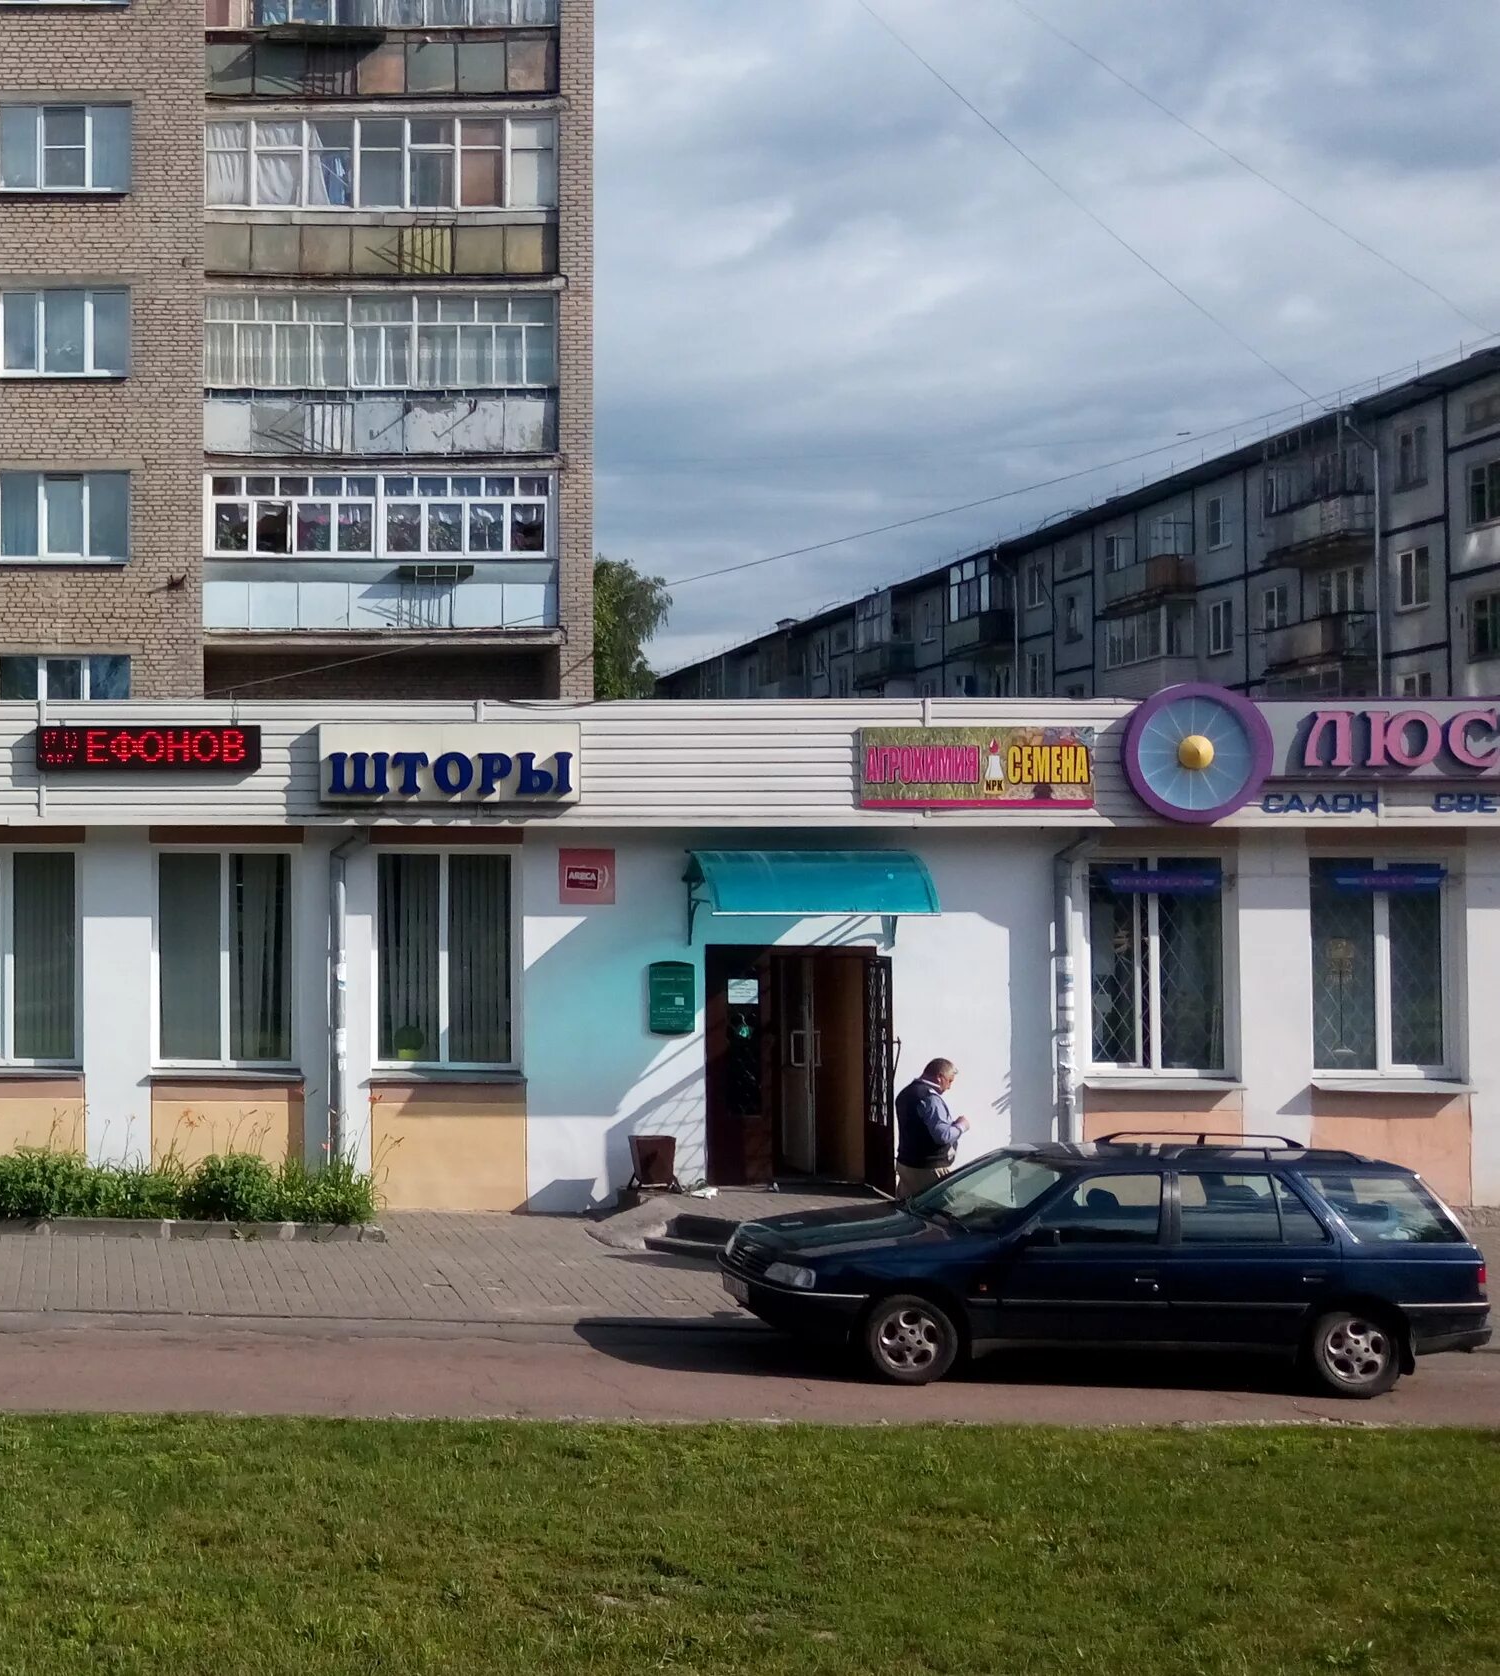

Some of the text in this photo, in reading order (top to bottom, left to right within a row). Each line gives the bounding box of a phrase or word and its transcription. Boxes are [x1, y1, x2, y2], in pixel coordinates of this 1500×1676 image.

[328, 751, 574, 796] ШТОРЫ
[865, 745, 980, 784] АГРОХИМИЯ
[1006, 745, 1091, 785] СЕМЕНА
[1260, 792, 1500, 814] САЛОН СВЕ
